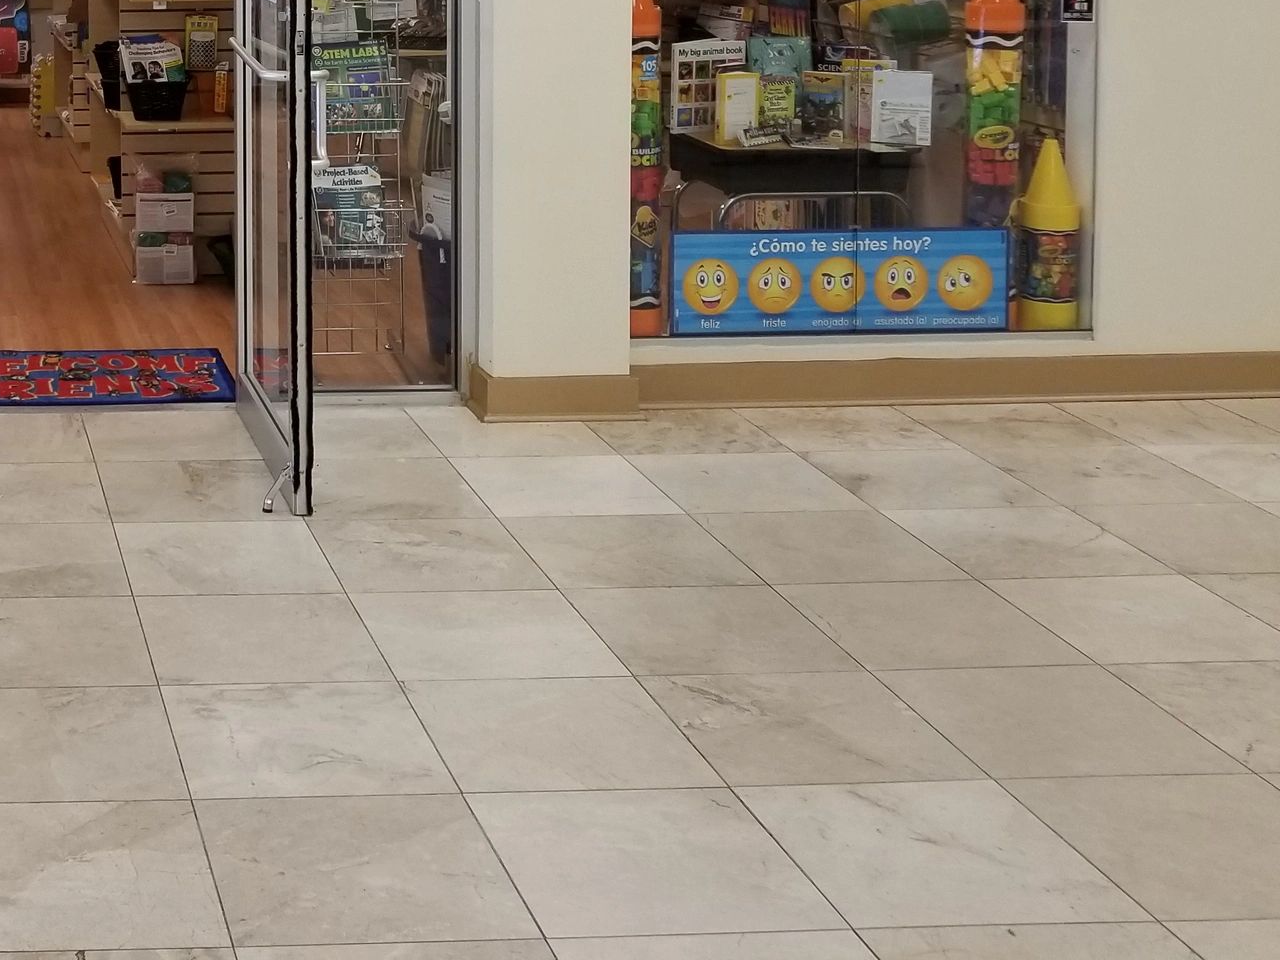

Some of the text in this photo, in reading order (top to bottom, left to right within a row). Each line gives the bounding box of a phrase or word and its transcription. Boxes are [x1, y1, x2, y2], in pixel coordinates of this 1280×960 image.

[321, 46, 379, 59] STEM LABS
[678, 44, 743, 57] My big animal book
[640, 60, 657, 71] 105
[817, 63, 842, 72] SCIEN
[322, 167, 369, 177] Project-Based
[331, 178, 363, 186] Activities
[750, 236, 932, 257] ¿Cómo te sientes hoy?
[700, 318, 720, 329] feliz
[763, 318, 787, 328] triste
[812, 317, 849, 328] enojado
[874, 316, 913, 325] asustado
[932, 316, 1000, 326] preocupado (a)
